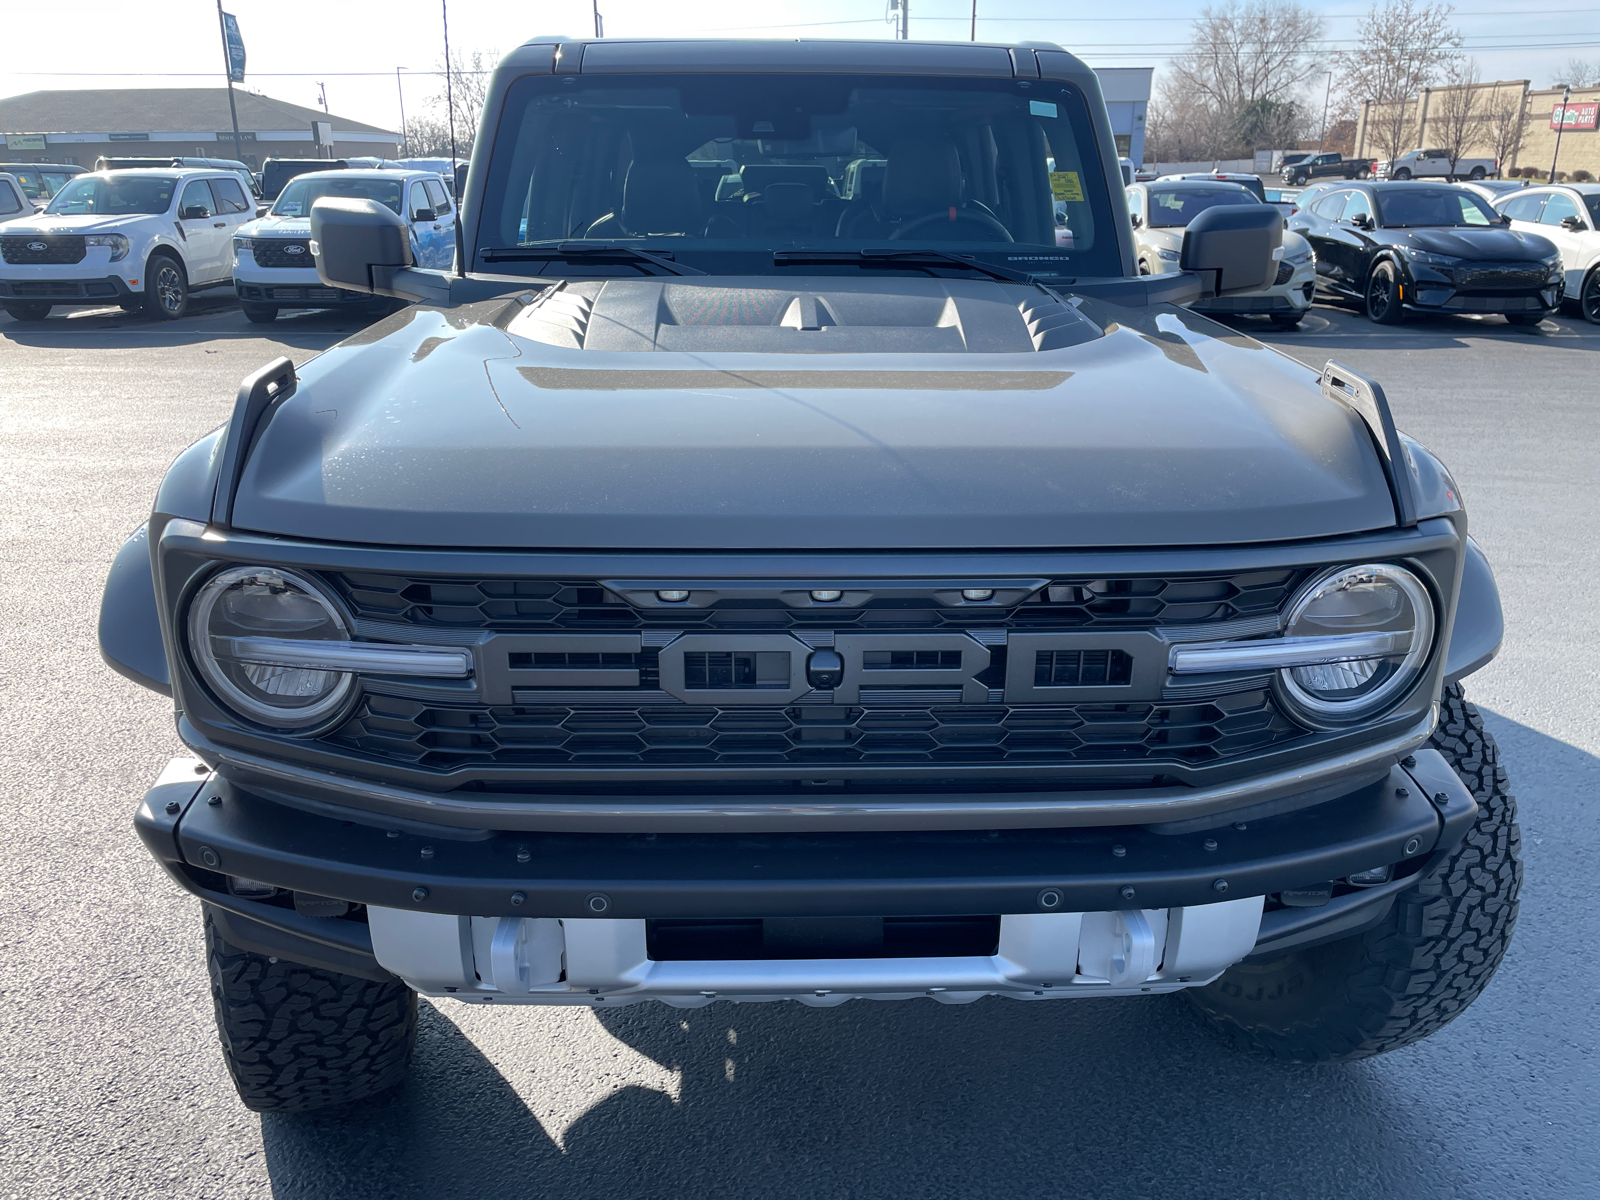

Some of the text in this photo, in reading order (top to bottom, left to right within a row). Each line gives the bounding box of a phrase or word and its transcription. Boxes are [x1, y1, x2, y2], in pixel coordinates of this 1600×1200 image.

[1581, 106, 1595, 115] AUTO
[1578, 115, 1595, 124] PARTS
[478, 631, 1164, 705] FORD
